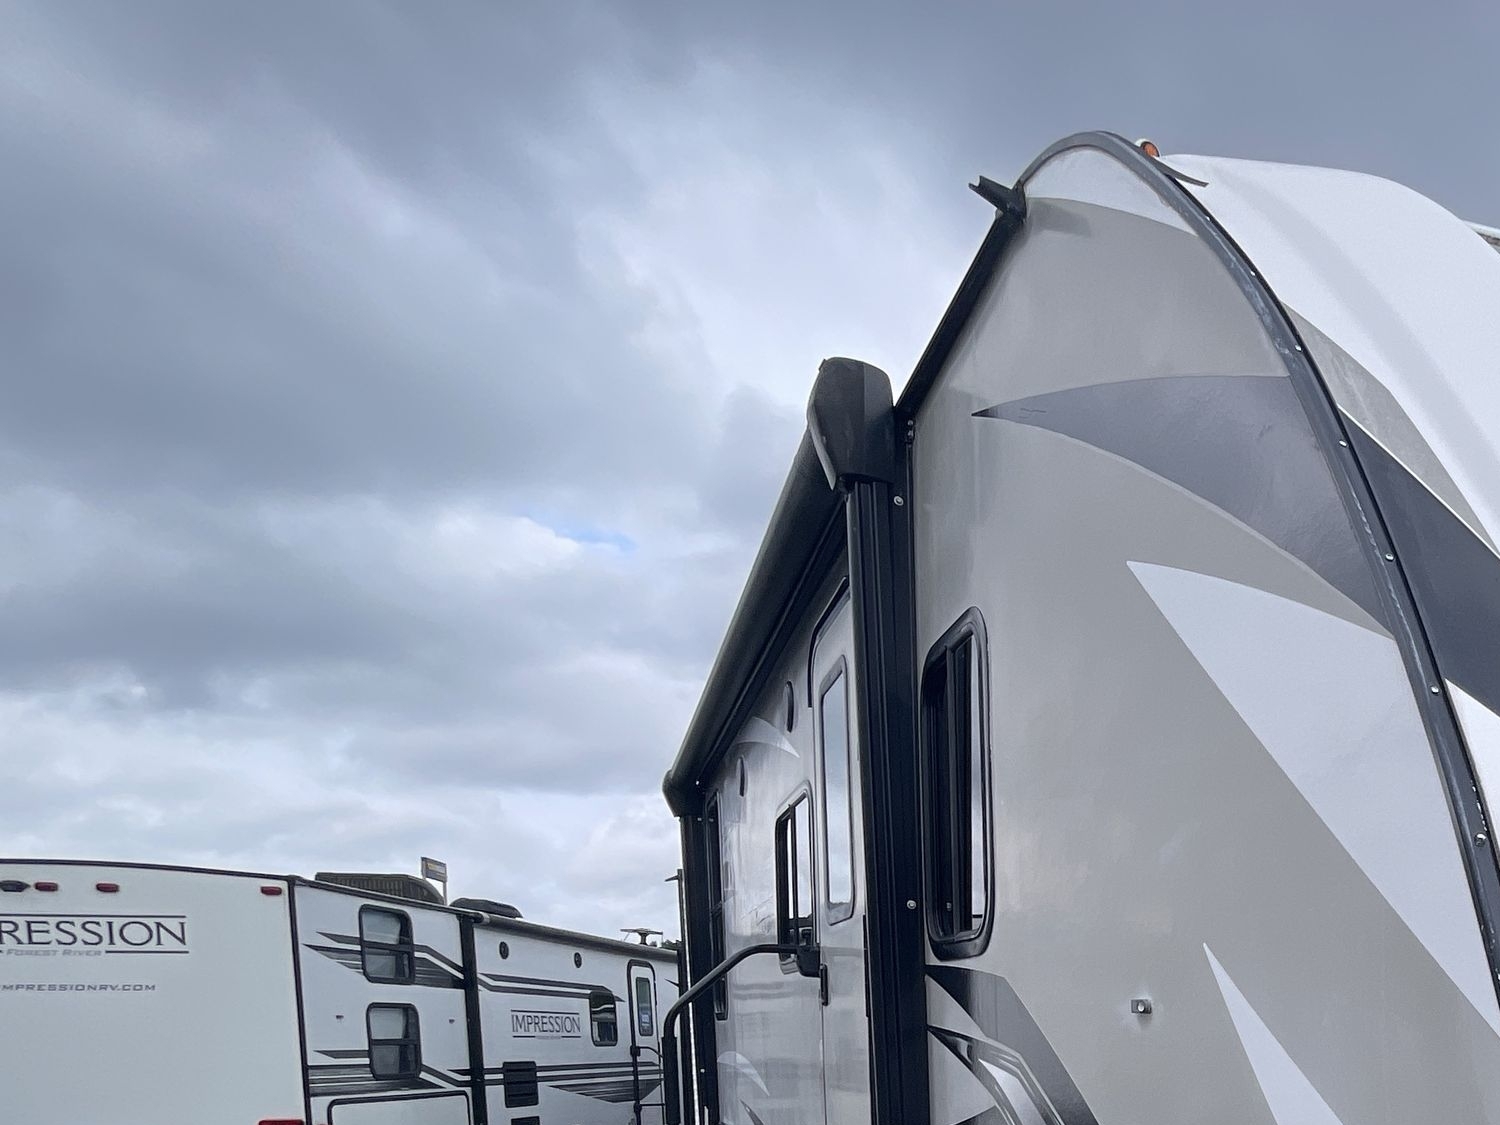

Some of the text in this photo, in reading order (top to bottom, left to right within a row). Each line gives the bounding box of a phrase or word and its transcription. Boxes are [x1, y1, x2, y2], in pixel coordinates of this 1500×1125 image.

[7, 948, 102, 957] FOREST RIVER
[511, 1014, 581, 1033] IMPRESSION
